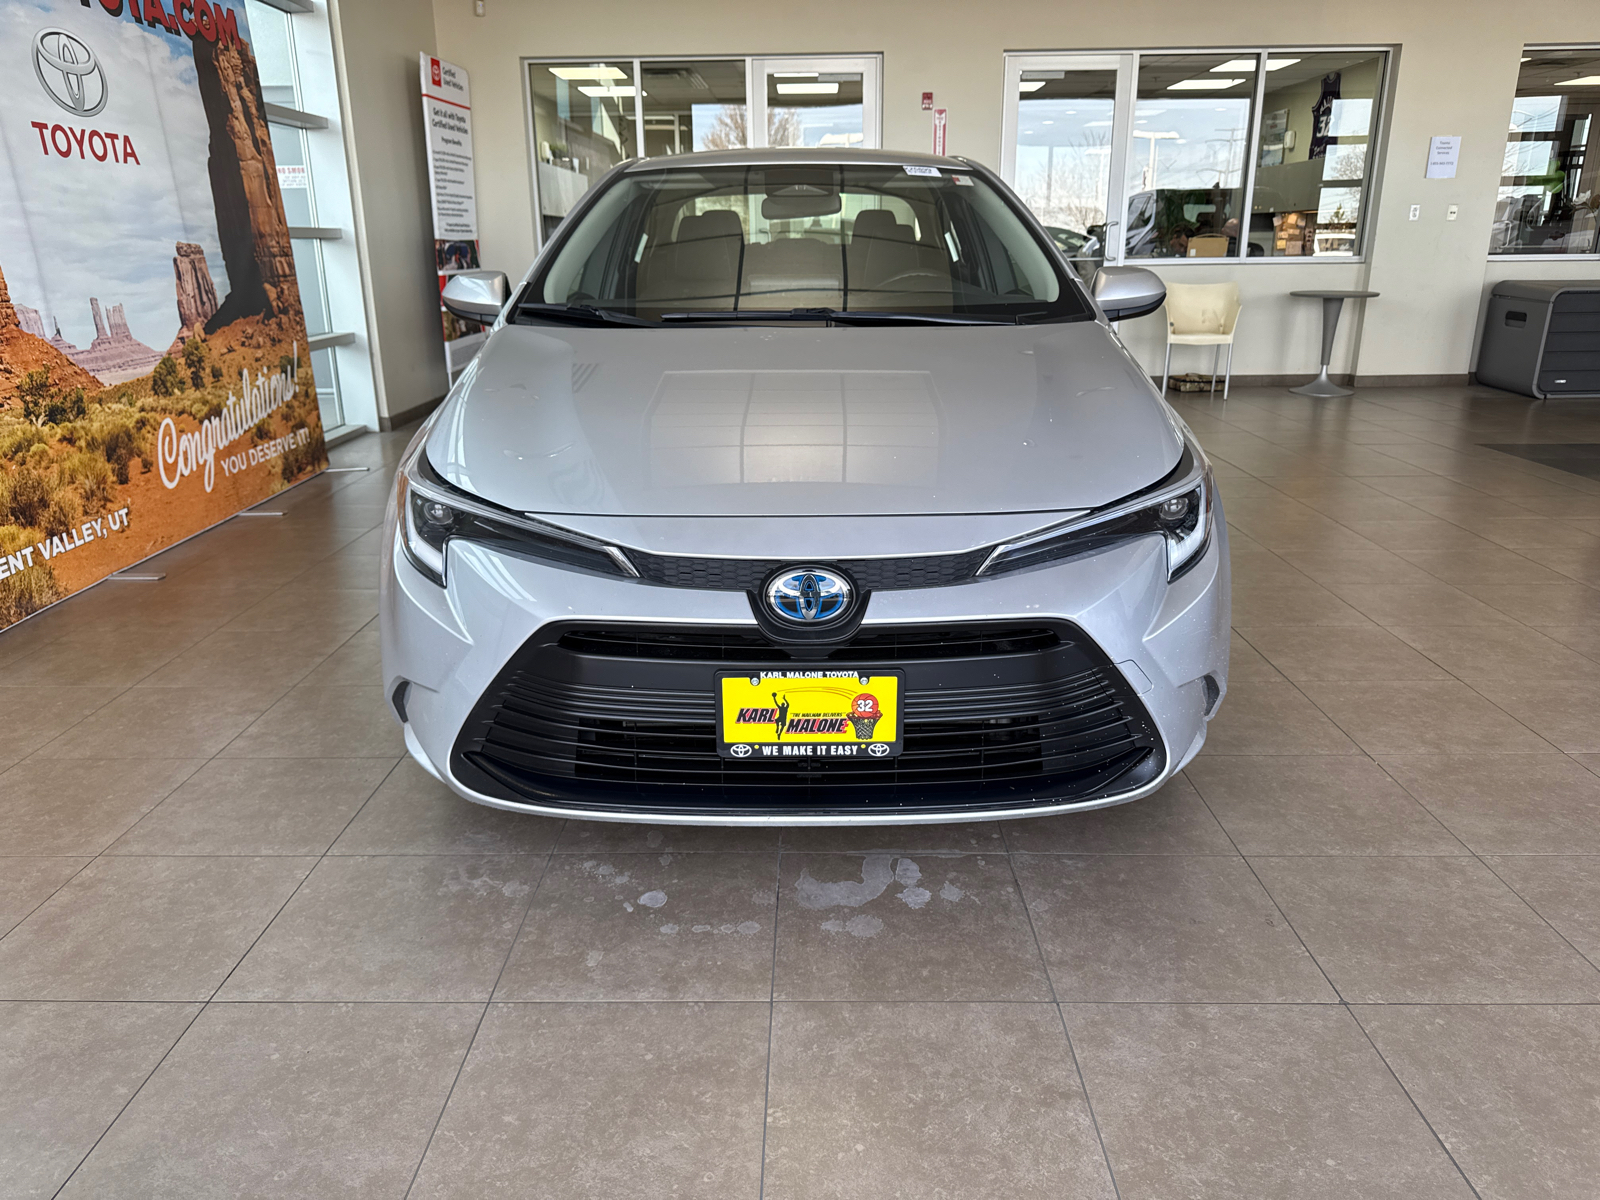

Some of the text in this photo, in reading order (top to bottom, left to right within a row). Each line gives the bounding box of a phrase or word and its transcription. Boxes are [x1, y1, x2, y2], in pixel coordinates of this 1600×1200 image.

[31, 121, 141, 166] TOYOTA
[158, 340, 300, 493] Congratulations!
[220, 427, 311, 477] YOU DESERVE IT!
[37, 518, 108, 561] VALLEY,
[107, 507, 128, 532] UT
[760, 671, 859, 679] KARL MALONE TOYOTA
[857, 700, 873, 712] 32
[736, 708, 778, 724] KARL
[785, 718, 848, 734] MALONE
[762, 745, 858, 756] WE MAKE IT EASY
